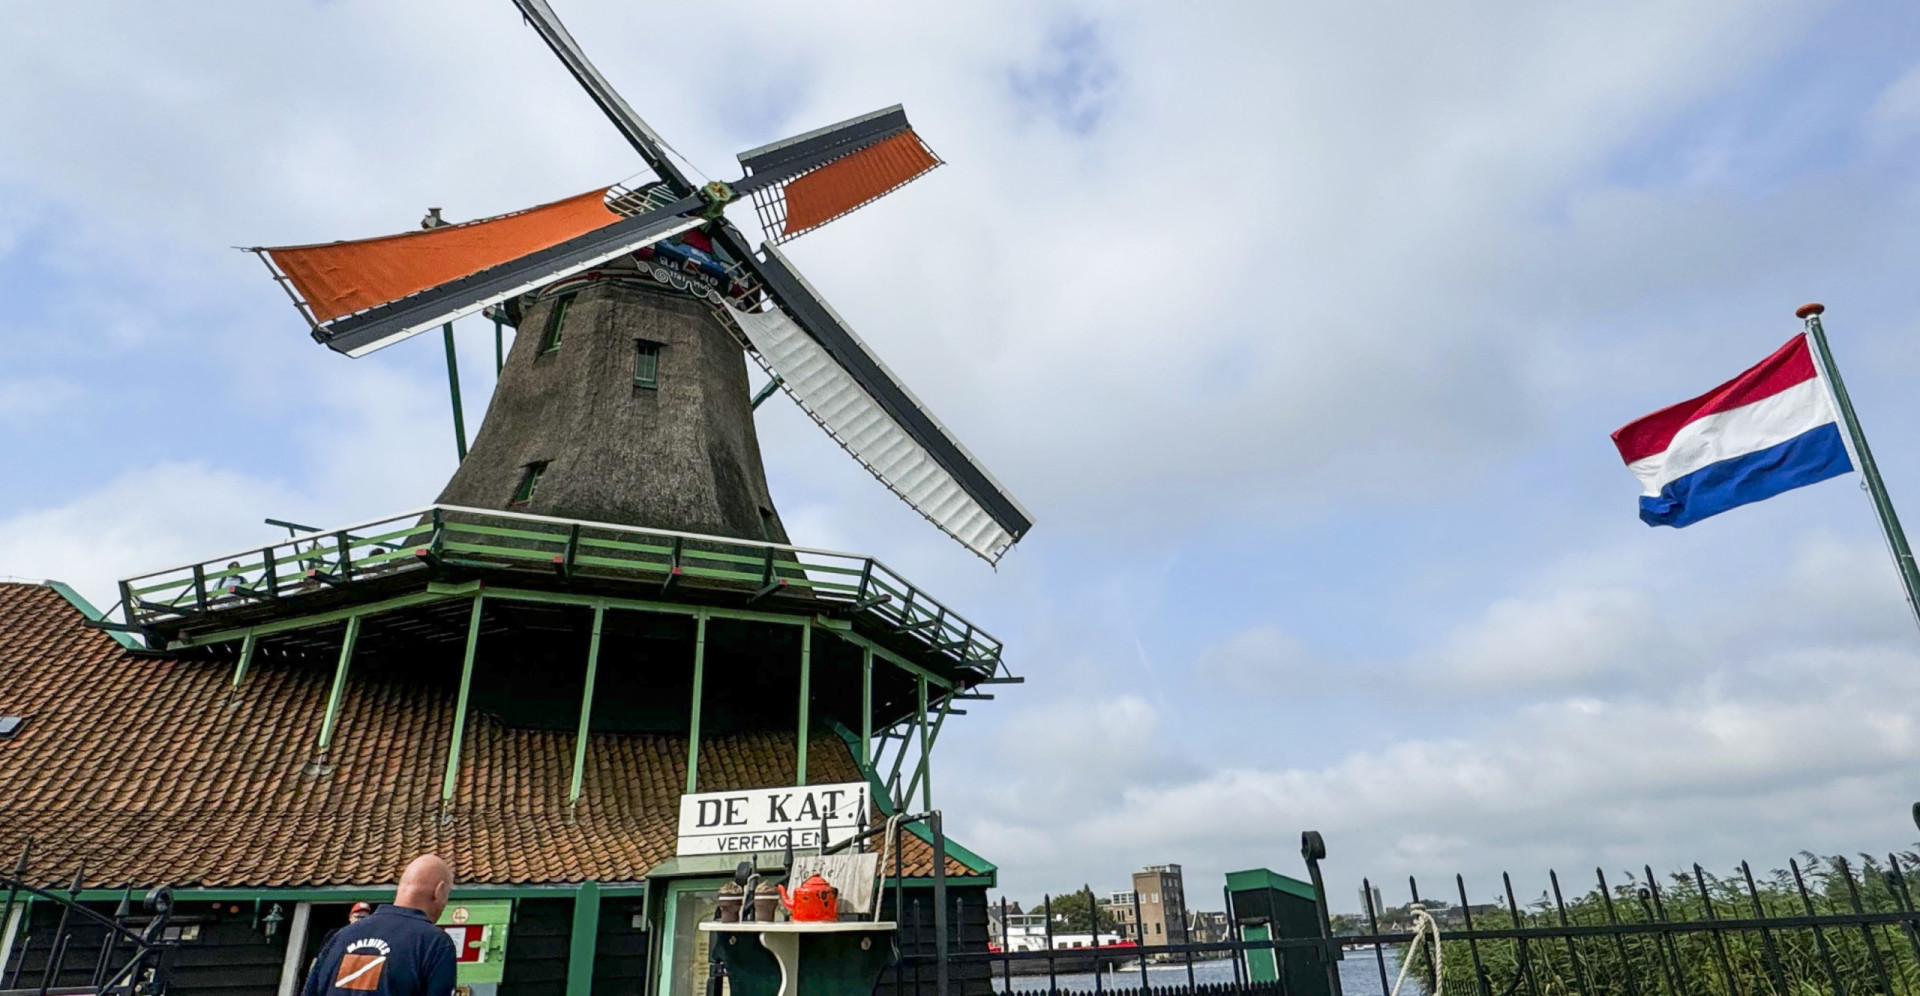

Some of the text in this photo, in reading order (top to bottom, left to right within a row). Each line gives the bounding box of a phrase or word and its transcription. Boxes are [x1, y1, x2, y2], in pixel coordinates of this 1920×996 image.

[696, 790, 853, 828] DE KAT.
[347, 938, 391, 955] MALDIVES
